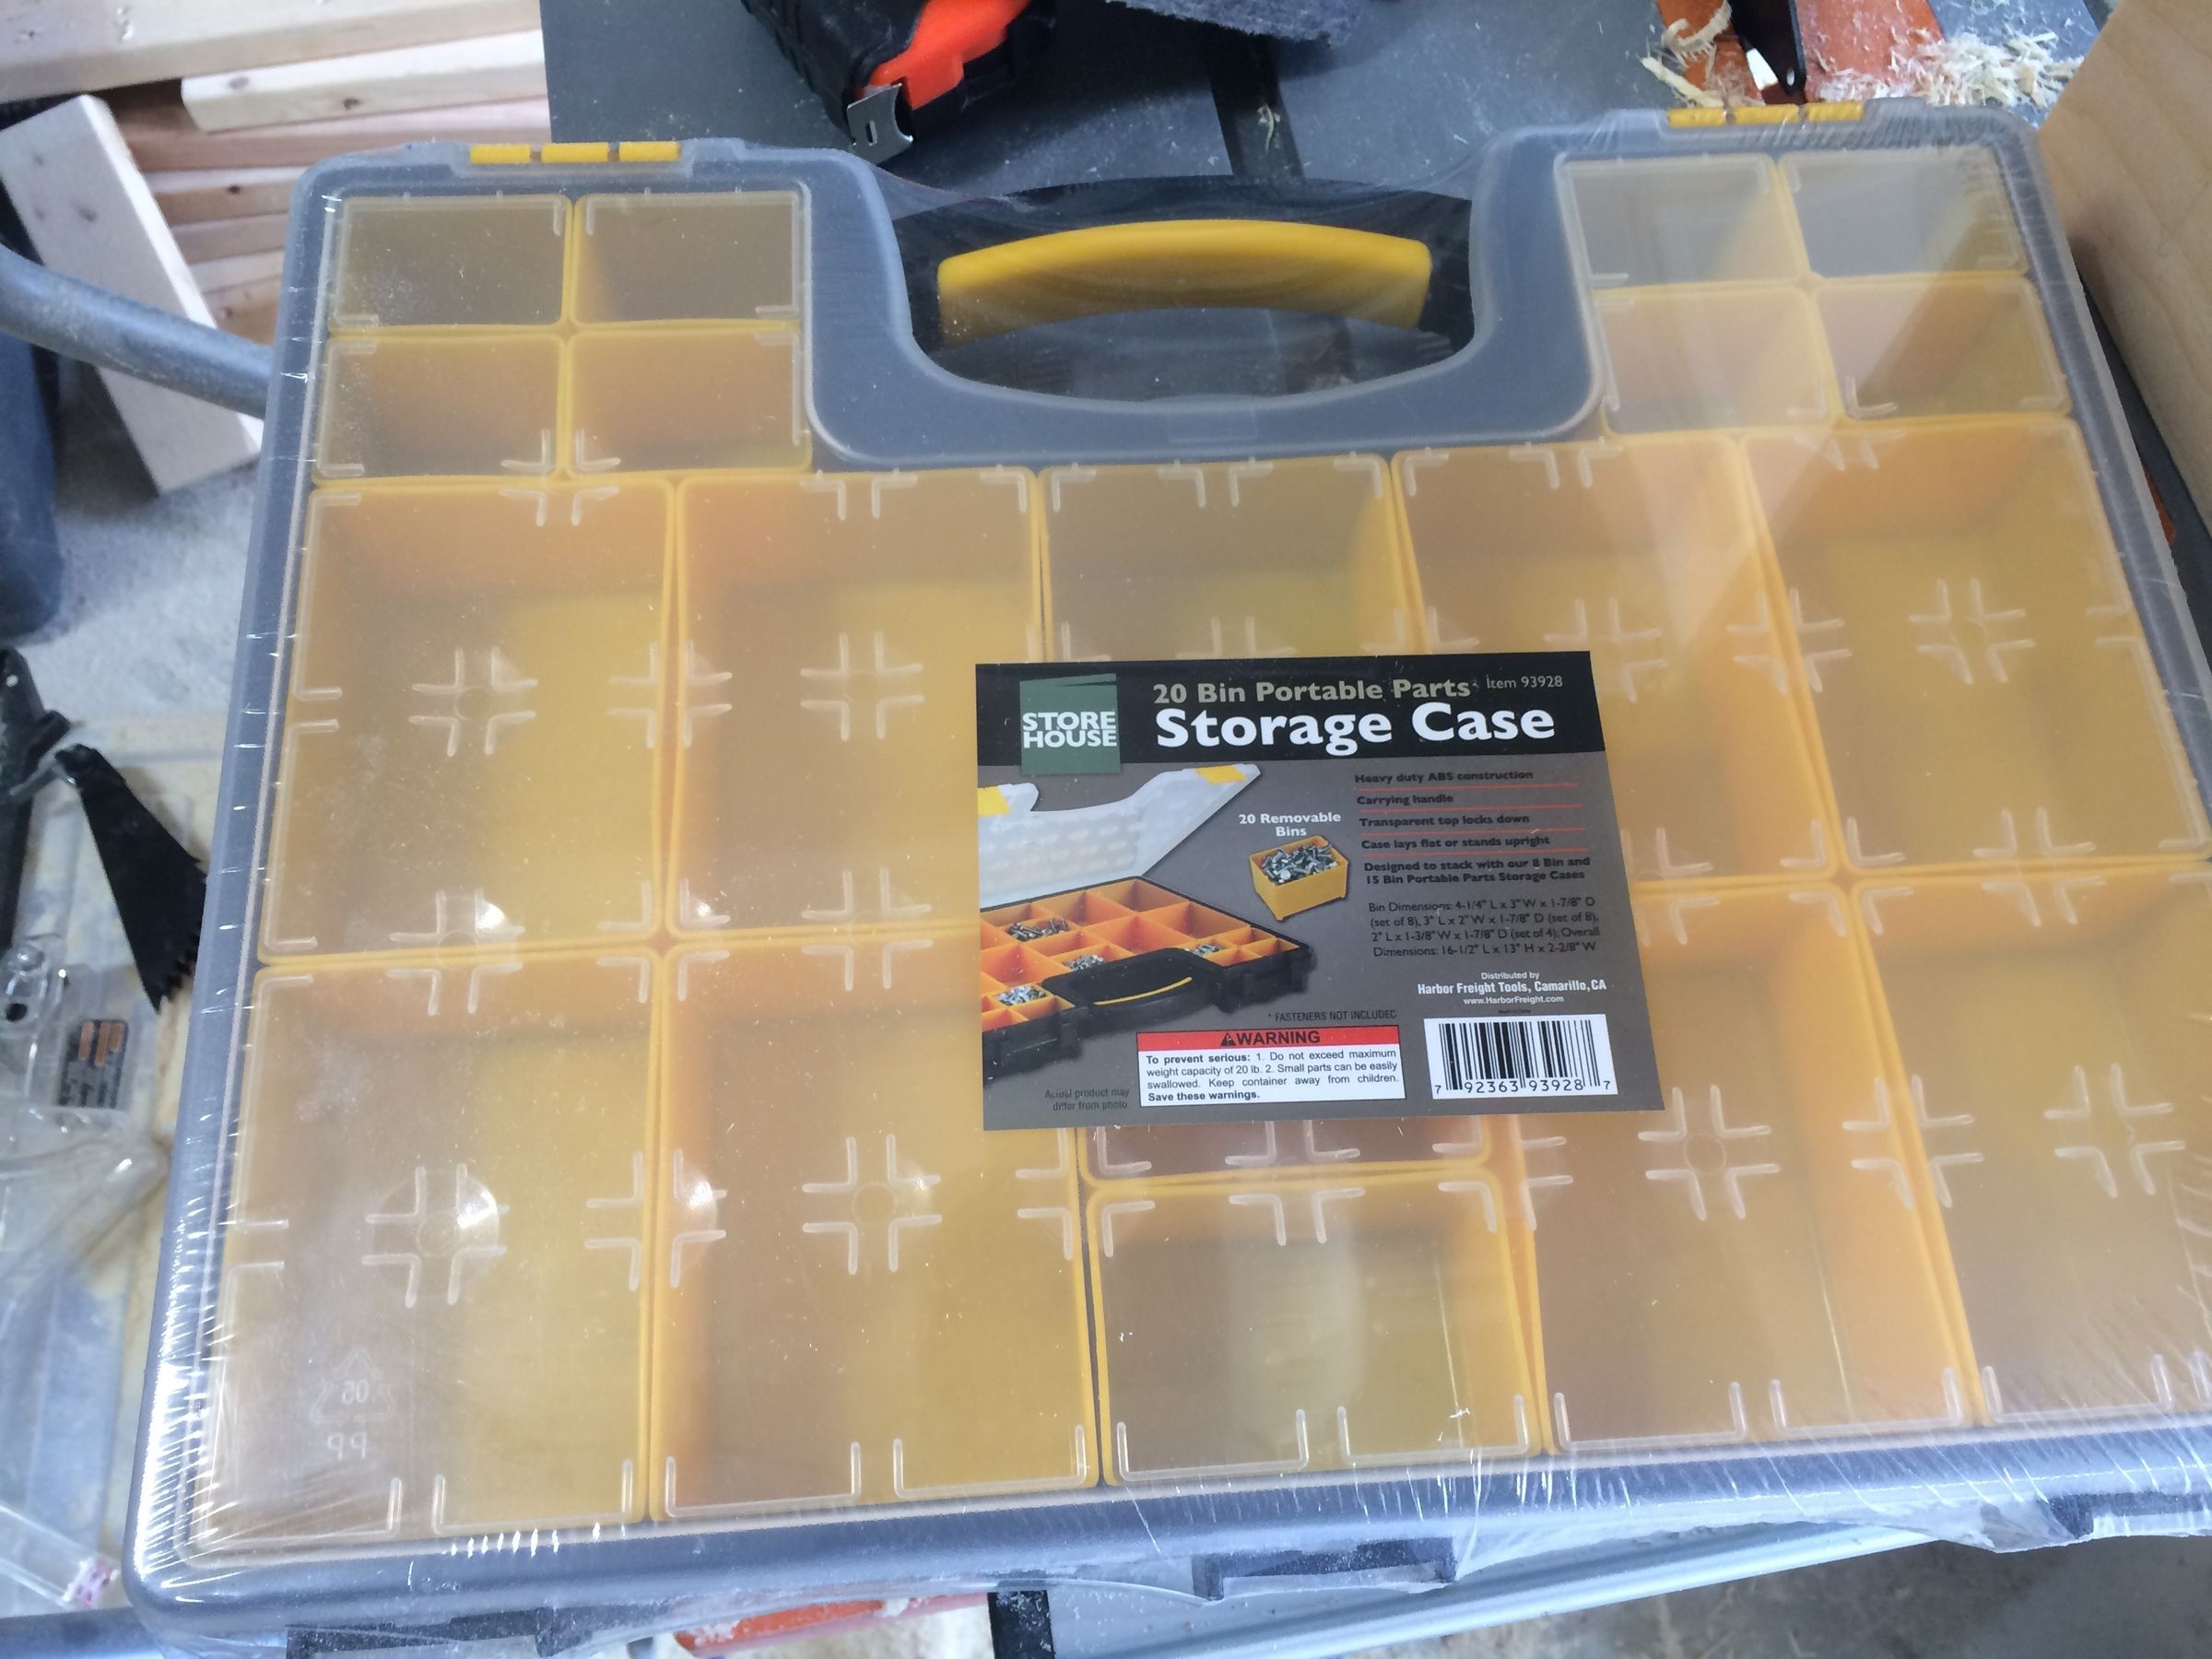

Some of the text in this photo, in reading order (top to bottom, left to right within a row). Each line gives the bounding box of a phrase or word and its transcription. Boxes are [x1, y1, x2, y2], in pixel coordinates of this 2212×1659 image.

[1487, 675, 1563, 689] Item 93928
[1154, 678, 1471, 704] 20 Bin Portable Parts
[1023, 712, 1116, 731] STORE
[1156, 701, 1555, 756] Storage Case
[1023, 730, 1117, 748] HOUSE
[1355, 771, 1534, 783] Heavy duty ABS construction
[1357, 794, 1453, 806] Carrying handle
[1239, 812, 1341, 824] 20 Removable
[1359, 815, 1530, 828] Transparent top locks down
[1276, 827, 1307, 836] Bins
[1361, 841, 1390, 849] Case
[1394, 840, 1417, 850] lays
[1420, 839, 1441, 847] flat
[1463, 838, 1501, 846] stands
[1505, 836, 1550, 847] upright
[1364, 862, 1420, 873] Designed
[1424, 862, 1436, 870] to
[1441, 861, 1473, 869] stack
[1477, 860, 1503, 868] with
[1533, 858, 1540, 866] 8
[1544, 858, 1563, 866] Bin
[1568, 857, 1590, 865] and
[1367, 871, 1585, 884] 15 Bin Portable Parts Storage Cases
[1369, 902, 1384, 912] Bin
[1389, 902, 1453, 911] Dimensions:
[1490, 900, 1497, 909] L
[1523, 900, 1535, 908] W
[1585, 897, 1595, 906] D
[1371, 919, 1390, 929] (set
[1394, 917, 1404, 925] of
[1439, 916, 1445, 924] L
[1471, 915, 1485, 924] W
[1535, 913, 1544, 923] D
[1548, 914, 1568, 924] (set
[1571, 912, 1582, 922] of
[1386, 933, 1392, 941] L
[1438, 931, 1452, 939] W
[1498, 929, 1507, 938] D
[1512, 929, 1531, 940] (set
[1534, 929, 1543, 937] of
[1561, 926, 1600, 936] Overall
[1373, 947, 1438, 957] Dimensions:
[1483, 945, 1489, 954] L
[1524, 944, 1534, 953] H
[1582, 942, 1596, 950] W
[1529, 971, 1539, 980] by
[1418, 984, 1453, 994] Harbor
[1457, 982, 1495, 995] Freight
[1499, 982, 1531, 993] Tools,
[1591, 979, 1607, 990] CA
[1464, 995, 1564, 1005] www.HarborFreight.com
[1276, 1012, 1326, 1021] FASTENERS
[1351, 1010, 1396, 1019] INCLUDED
[1236, 1030, 1320, 1044] WARNING
[1164, 1055, 1204, 1065] prevent
[1208, 1053, 1250, 1062] serious:
[1289, 1052, 1303, 1060] not
[1309, 1051, 1344, 1059] exceed
[1349, 1049, 1396, 1058] maximum
[1147, 1067, 1178, 1078] weight
[1182, 1066, 1220, 1077] capacity
[1224, 1065, 1233, 1074] of
[1236, 1065, 1248, 1074] 20
[1252, 1065, 1263, 1074] lb.
[1265, 1065, 1275, 1073] 2.
[1277, 1064, 1304, 1072] Small
[1308, 1064, 1331, 1073] parts
[1356, 1062, 1366, 1070] be
[1370, 1062, 1397, 1071] easily
[1147, 1075, 1399, 1088] swallowed. Keep container away from children.
[1435, 1079, 1610, 1094] 7 92363 93928 7
[1045, 1088, 1129, 1100] Actual product may
[1178, 1092, 1205, 1100] these
[1209, 1090, 1259, 1100] warnings.
[1053, 1102, 1075, 1111] differ
[1078, 1101, 1100, 1110] from
